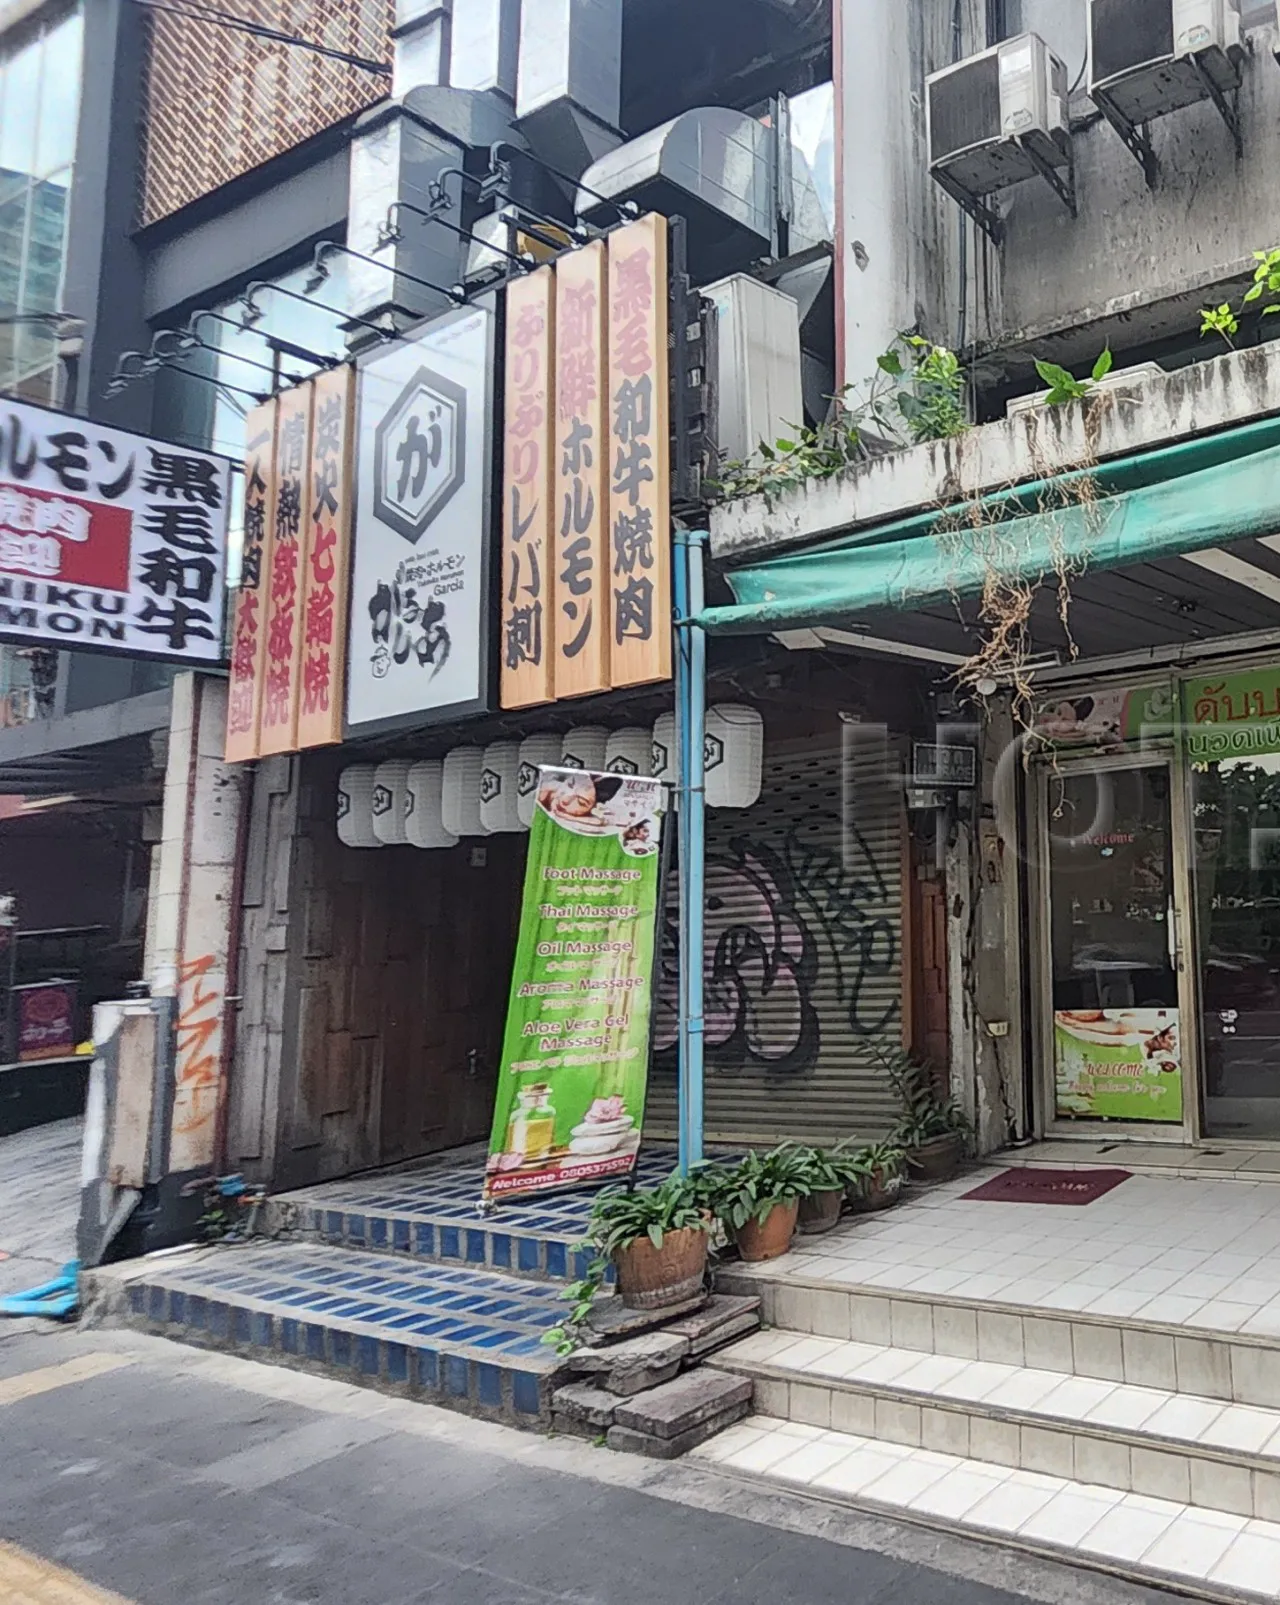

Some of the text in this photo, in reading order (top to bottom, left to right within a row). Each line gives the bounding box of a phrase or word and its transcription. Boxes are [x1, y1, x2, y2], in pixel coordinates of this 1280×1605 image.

[613, 246, 654, 646] 黒毛和牛焼肉
[560, 278, 597, 658] 新鮮ホルモン
[137, 446, 223, 650] 黒毛和牛
[544, 867, 641, 883] Foot Massage
[539, 904, 639, 920] Thai Massage
[538, 941, 633, 957] Oil Massage
[517, 976, 645, 998] Aroma Massage
[521, 1014, 629, 1037] Aloe Vera Gel
[539, 1035, 613, 1053] Massage
[492, 1172, 556, 1191] Welcome
